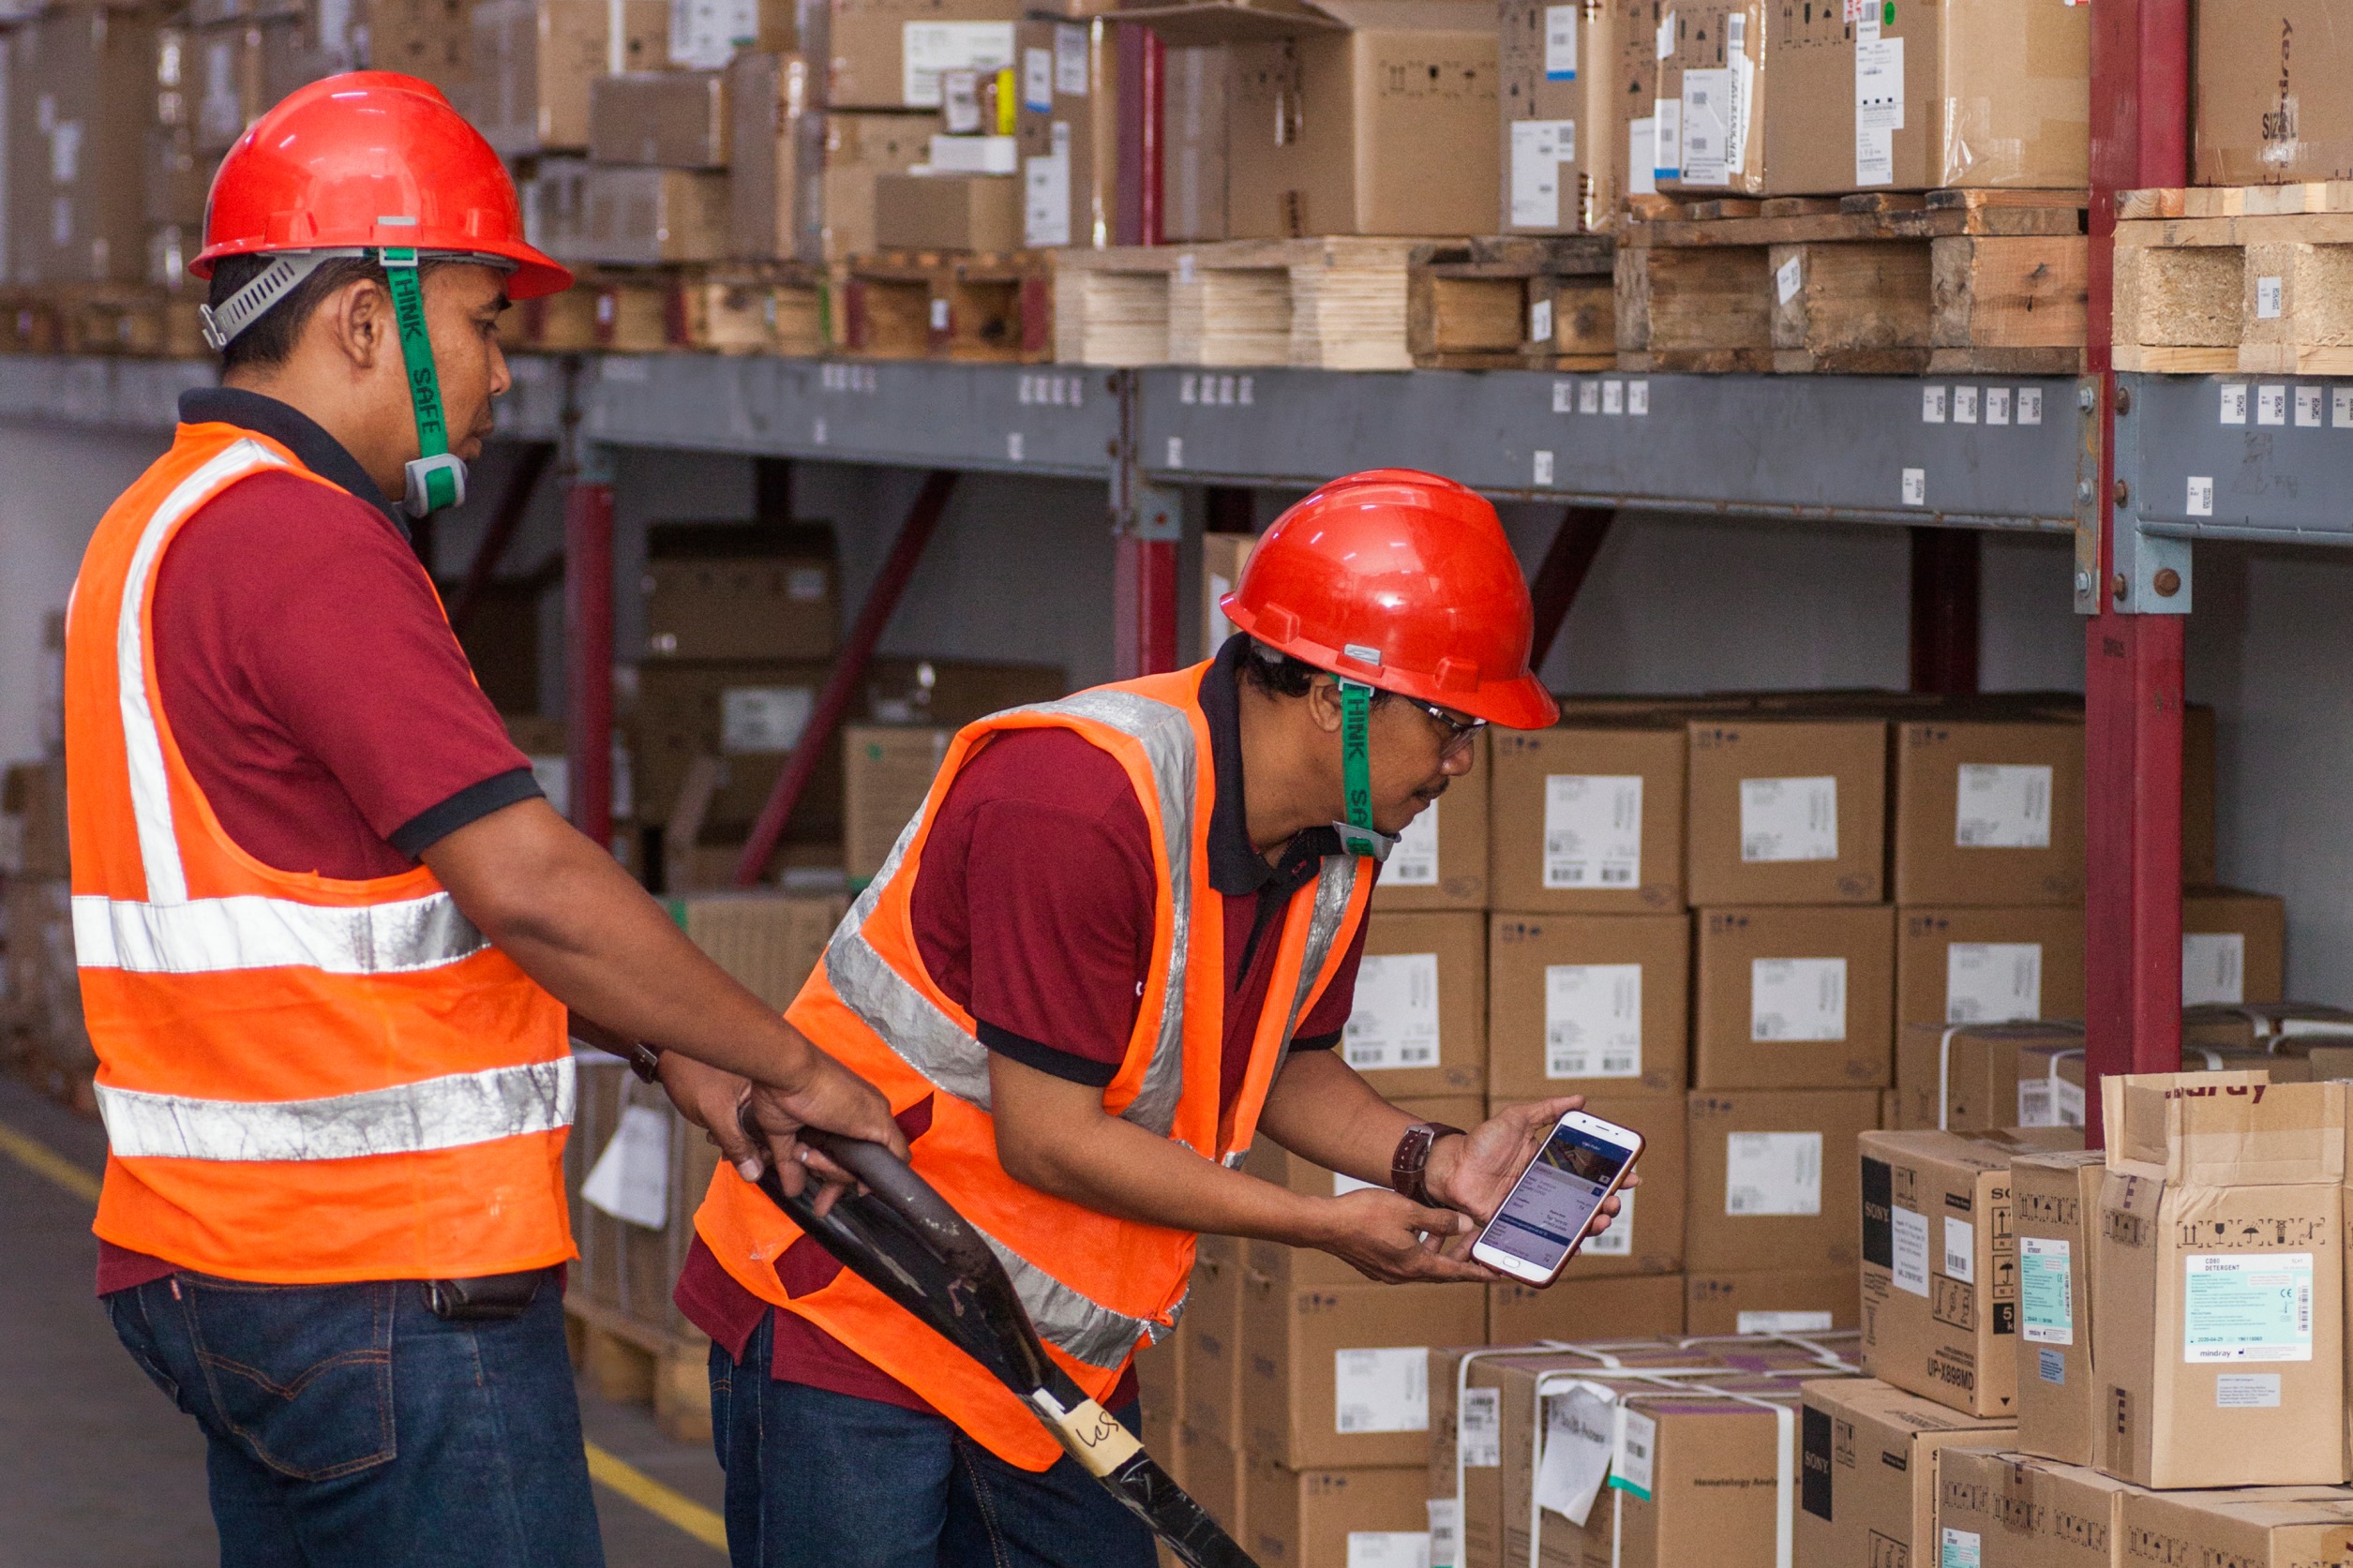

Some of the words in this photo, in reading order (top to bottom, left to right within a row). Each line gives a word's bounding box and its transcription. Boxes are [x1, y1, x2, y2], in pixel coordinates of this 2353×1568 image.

[393, 267, 422, 341] THINK
[412, 366, 441, 435] SAFE
[1350, 789, 1369, 826] SA
[1865, 1202, 1890, 1222] SONY
[2200, 1350, 2231, 1358] mindray
[1927, 1357, 1974, 1391] UP-X898MD
[1805, 1451, 1829, 1474] SONY
[1693, 1477, 1750, 1489] Hematology
